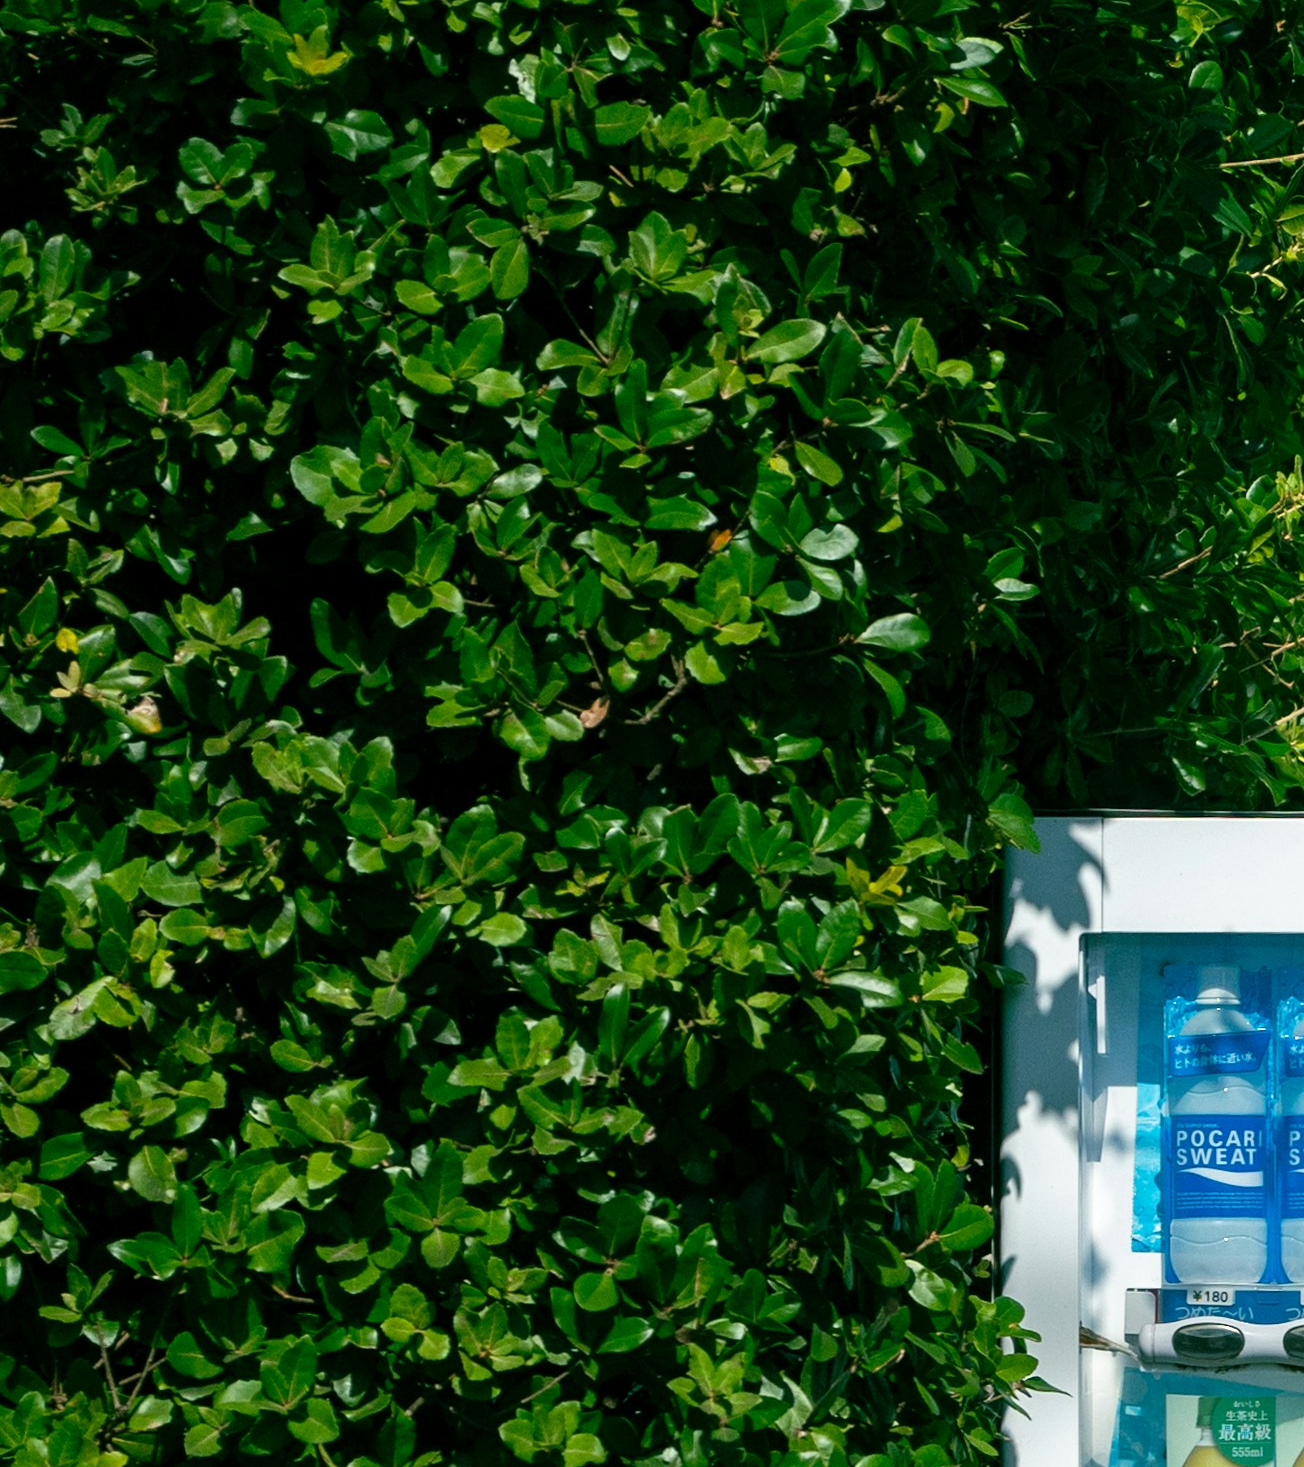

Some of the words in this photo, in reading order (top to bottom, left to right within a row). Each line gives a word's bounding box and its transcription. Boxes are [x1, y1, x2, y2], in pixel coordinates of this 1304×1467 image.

[1176, 1129, 1263, 1148] POCARI
[1176, 1148, 1258, 1166] SWEAT
[1192, 1290, 1228, 1304] ¥180
[1218, 1423, 1273, 1442] 最高級
[1231, 1446, 1265, 1459] 555ml
